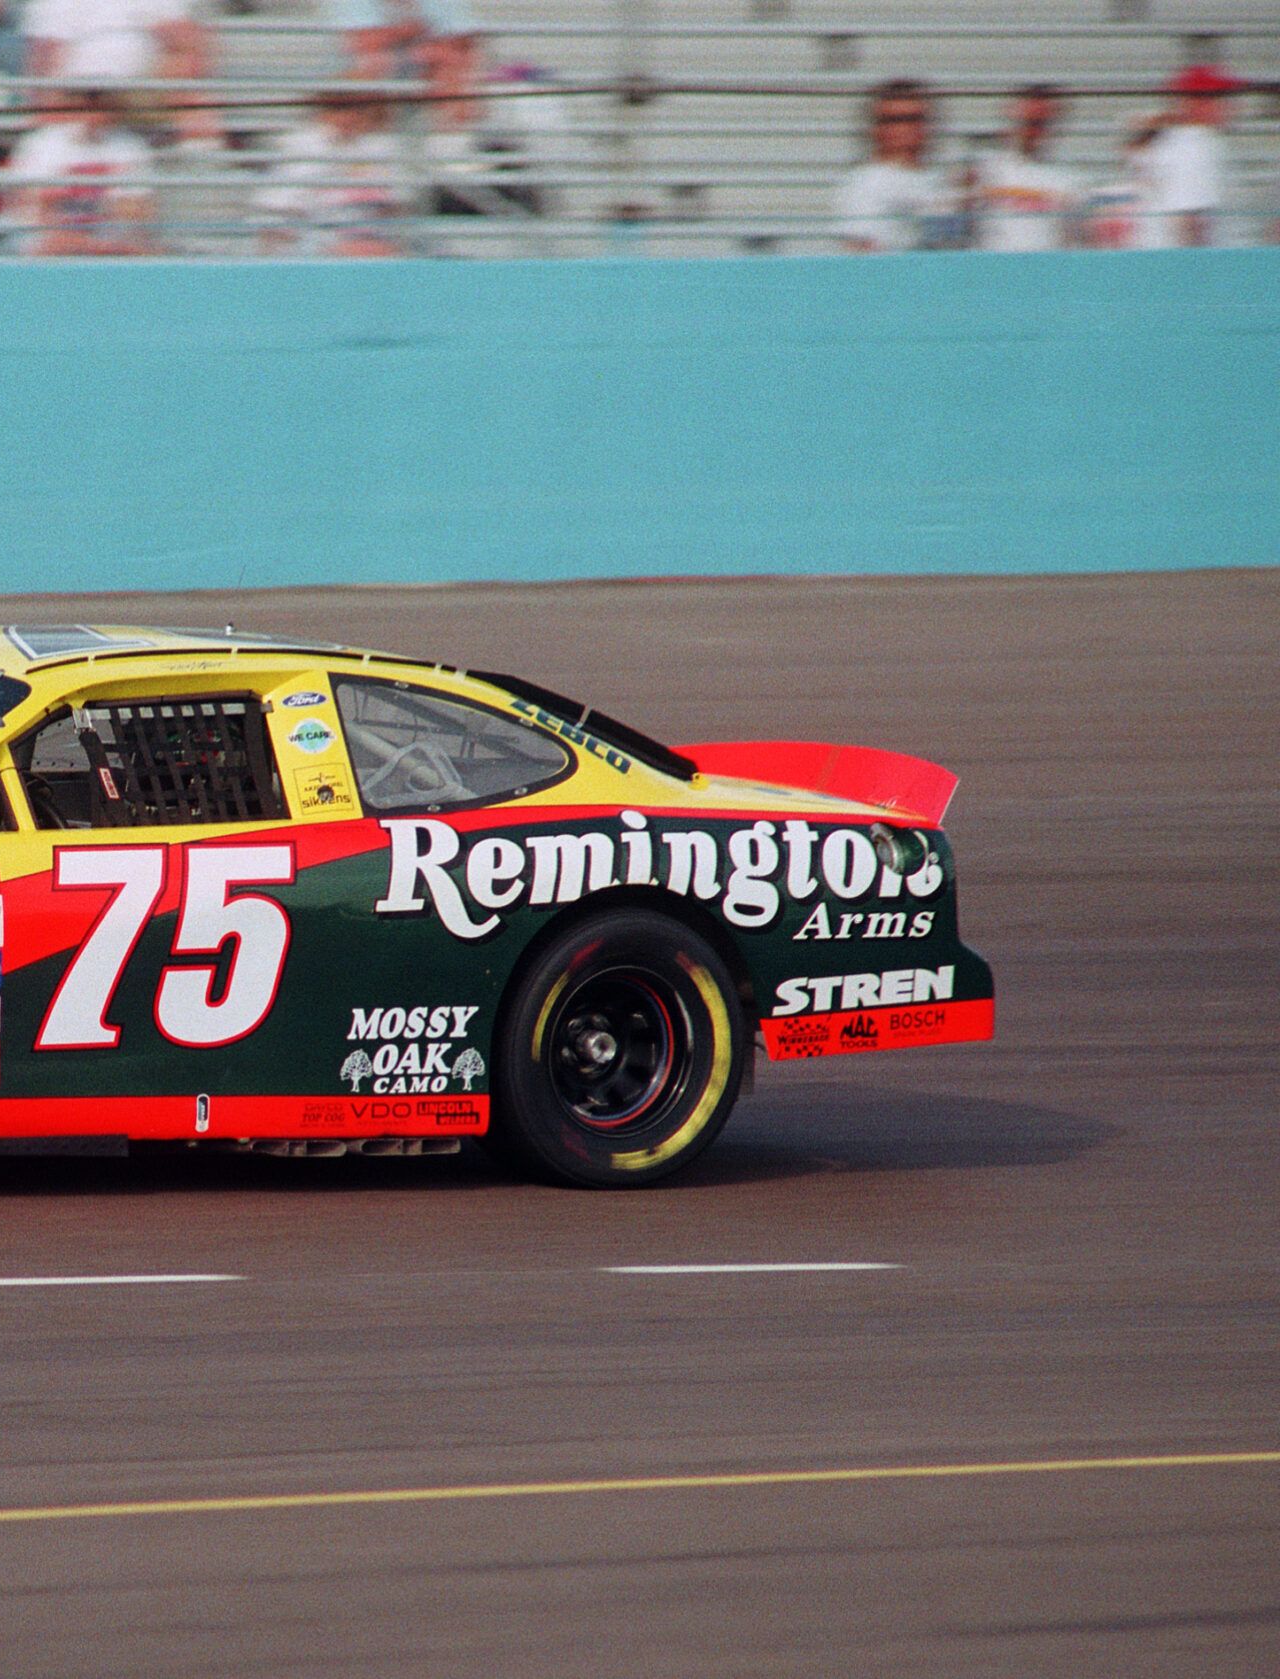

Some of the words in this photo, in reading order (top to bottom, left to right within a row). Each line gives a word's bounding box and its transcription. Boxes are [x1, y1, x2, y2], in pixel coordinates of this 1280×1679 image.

[286, 694, 322, 706] Ford
[792, 901, 936, 940] Arms
[33, 840, 297, 1052] 75
[771, 964, 956, 1017] STREN
[346, 1006, 480, 1041] MOSSY
[839, 1013, 879, 1040] MAC
[889, 1009, 946, 1030] BOSCH
[839, 1039, 879, 1048] TOOLS
[372, 1043, 453, 1076] OAK
[373, 1076, 448, 1094] CAMO
[350, 1102, 412, 1119] VDO
[418, 1102, 473, 1115] LINCOLN
